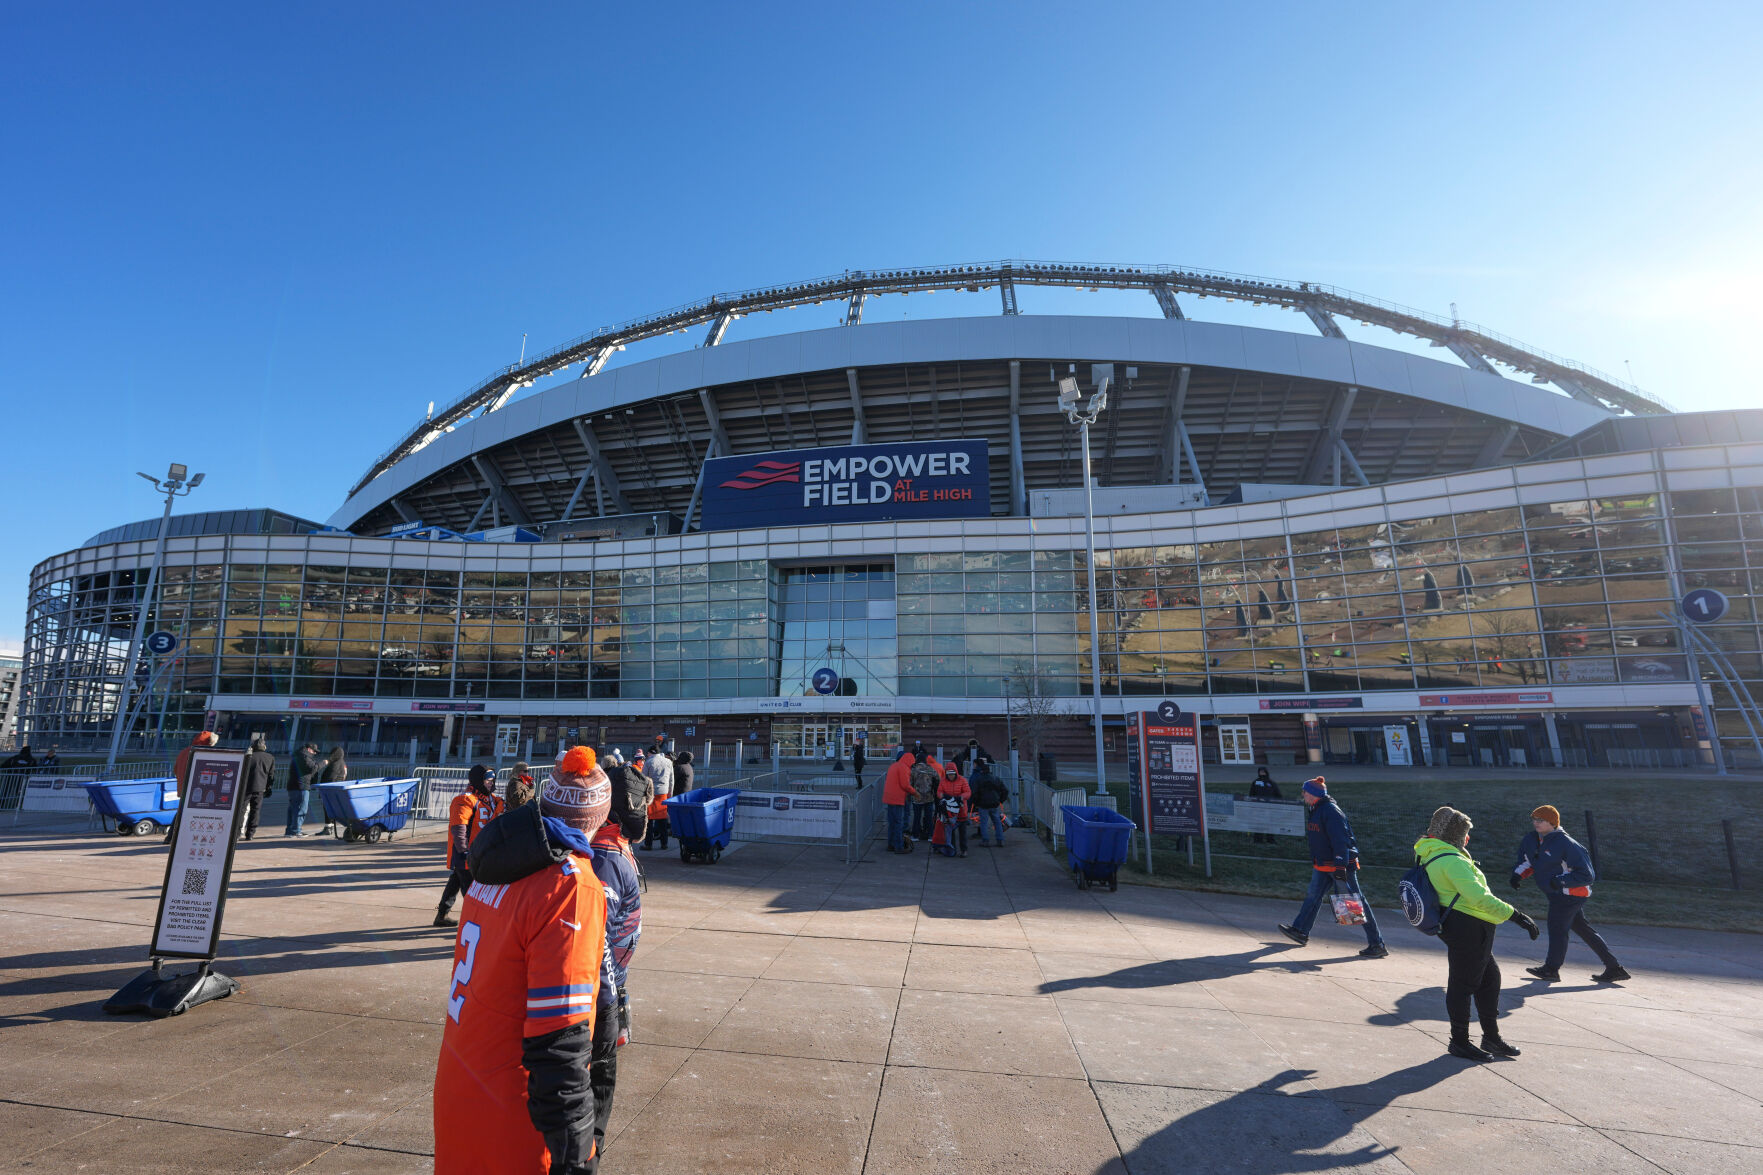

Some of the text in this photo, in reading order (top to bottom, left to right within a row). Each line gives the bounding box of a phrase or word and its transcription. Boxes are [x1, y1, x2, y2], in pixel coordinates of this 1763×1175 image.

[803, 452, 971, 483] EMPOWER
[803, 480, 892, 507] FIELD
[894, 479, 912, 491] AT
[894, 488, 972, 503] MILE HIGH
[403, 521, 419, 530] LIGHT
[1693, 596, 1709, 615] 1
[156, 636, 169, 649] 3
[819, 673, 831, 689] 2
[1164, 706, 1174, 717] 2
[544, 781, 607, 805] RONCOS
[447, 919, 481, 1025] 2
[603, 931, 618, 997] ONCOS
